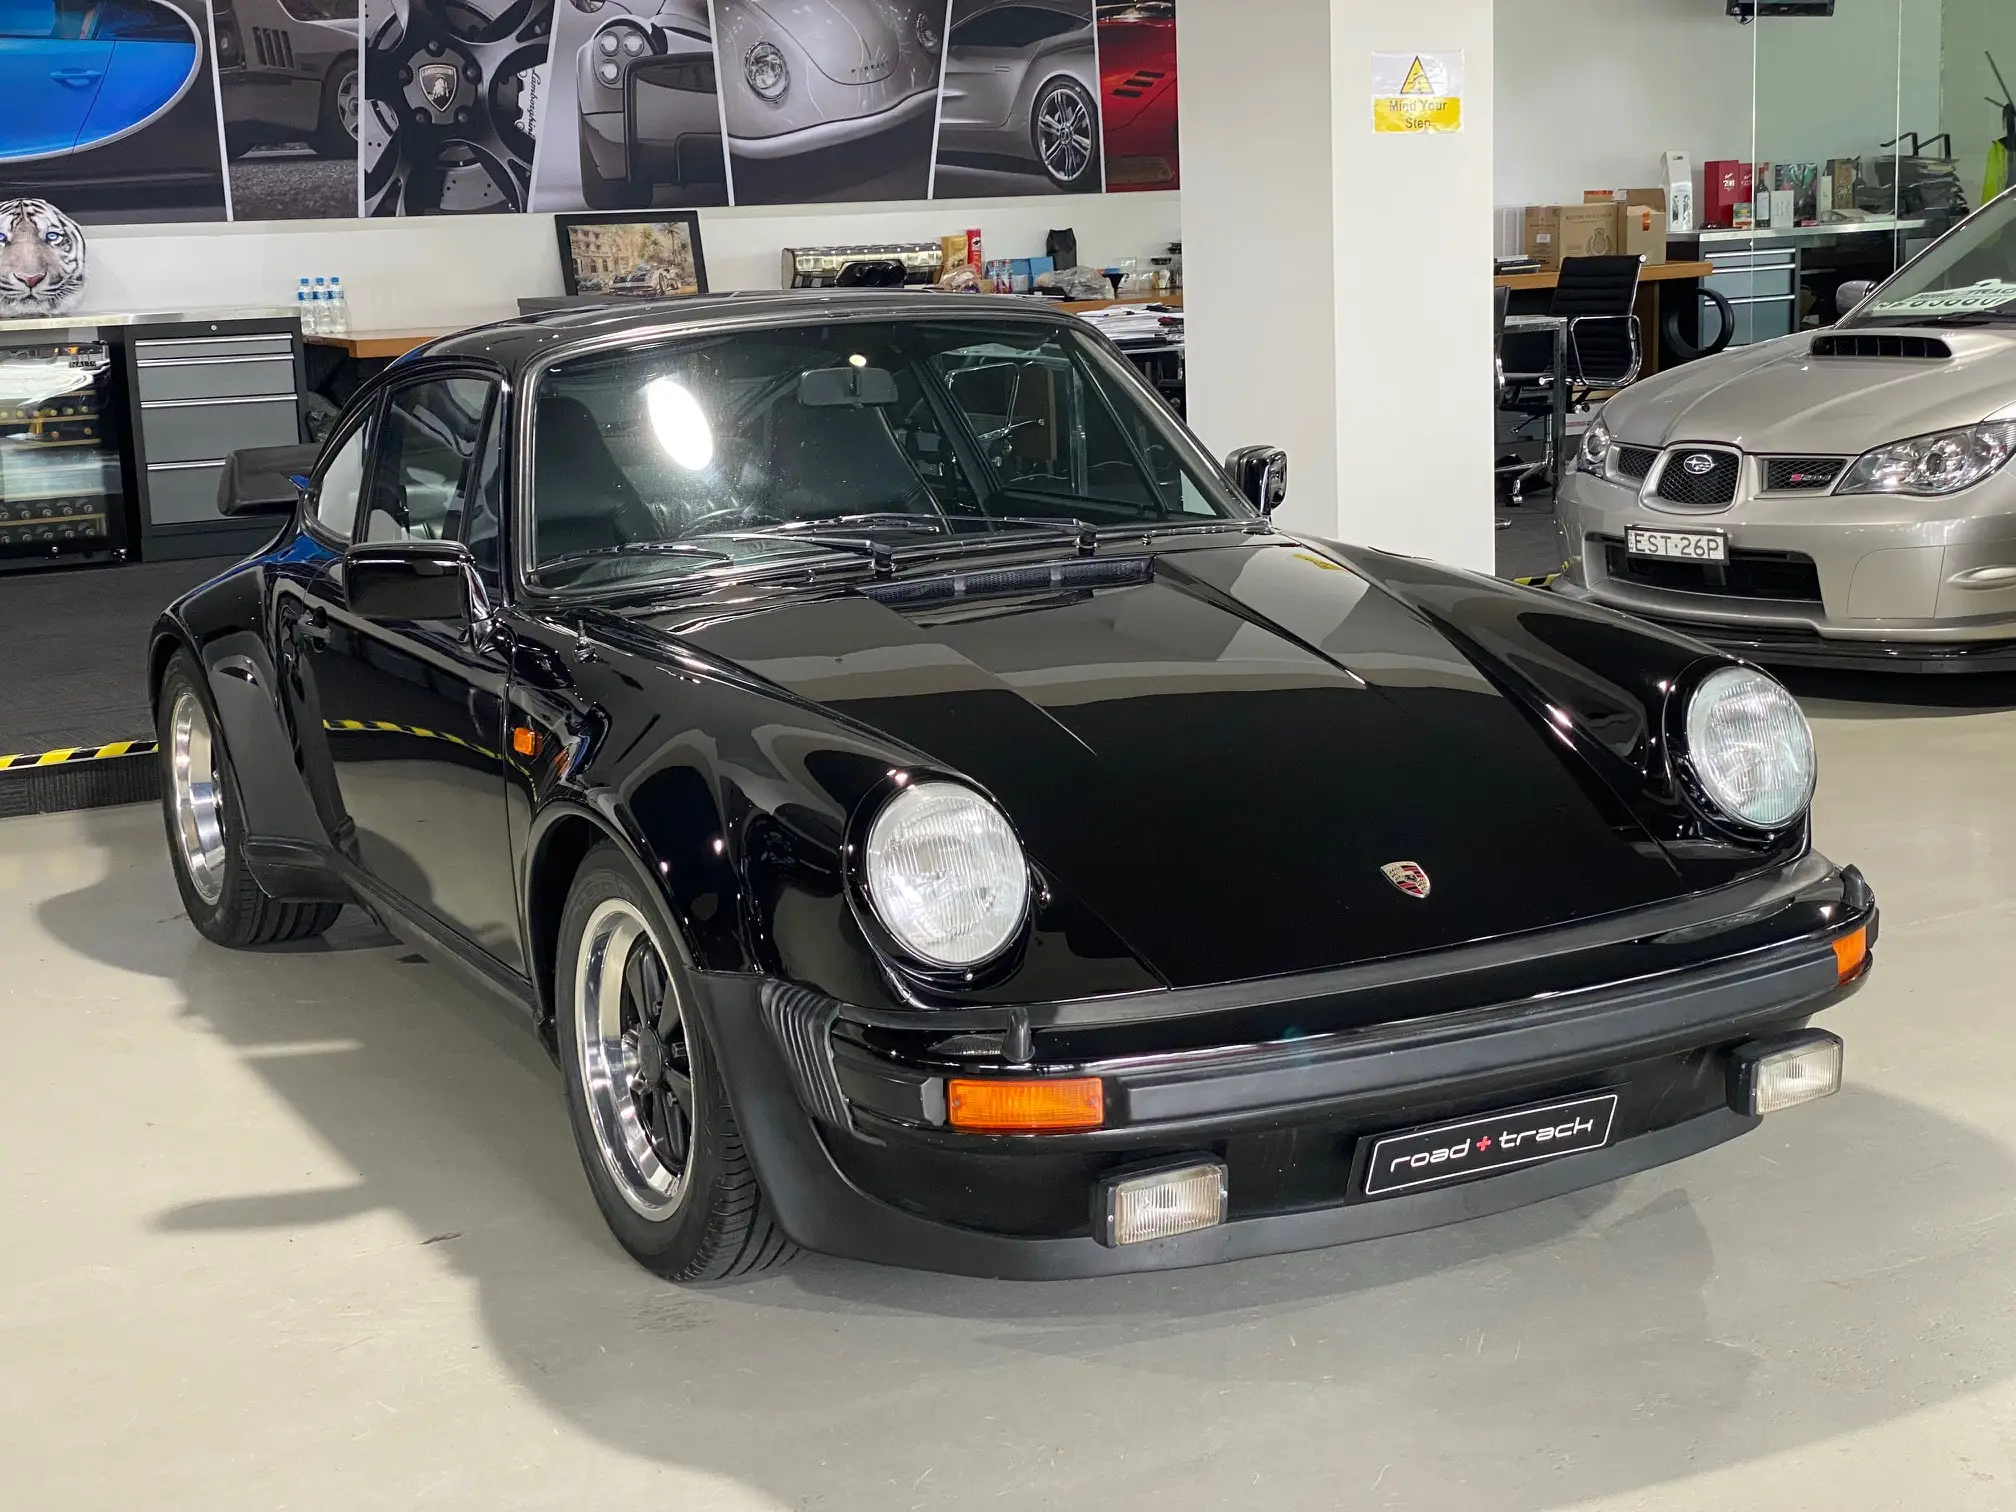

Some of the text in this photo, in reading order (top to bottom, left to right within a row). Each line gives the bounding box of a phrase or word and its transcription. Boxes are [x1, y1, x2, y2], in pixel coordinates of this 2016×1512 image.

[1389, 100, 1447, 112] Mind Your
[1405, 117, 1431, 131] Step
[1390, 1138, 1471, 1172] road
[1499, 1116, 1594, 1149] track
